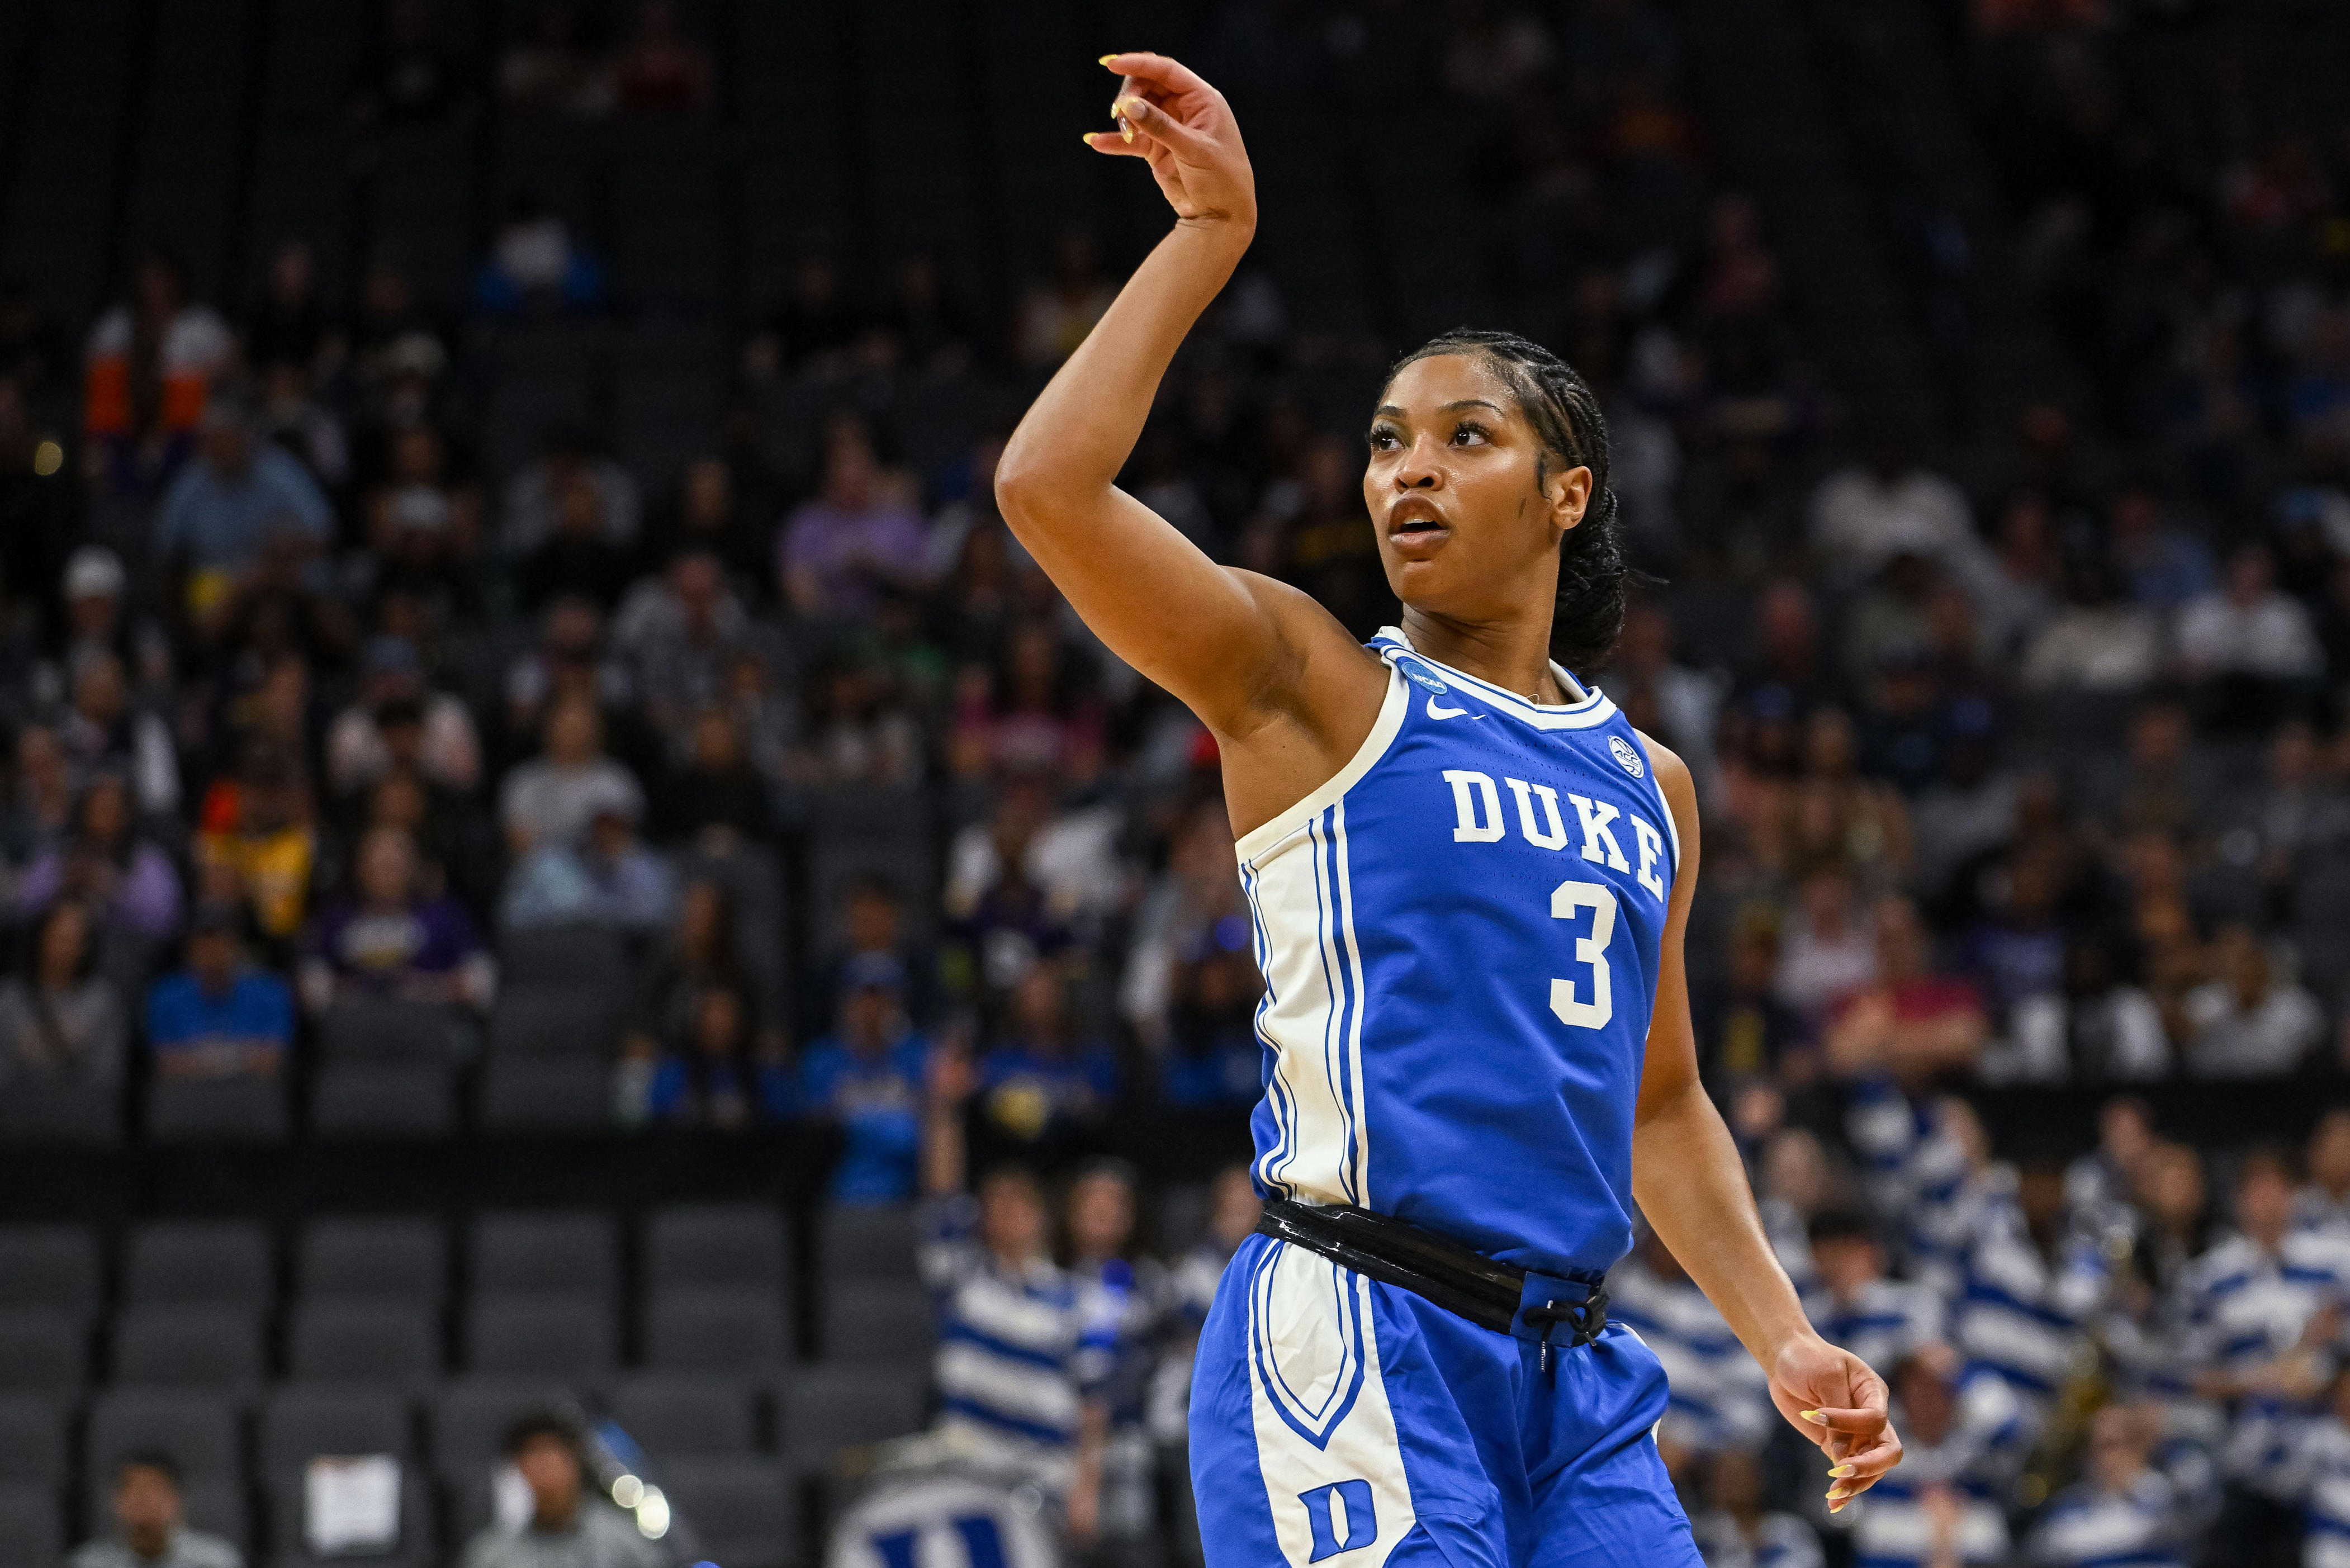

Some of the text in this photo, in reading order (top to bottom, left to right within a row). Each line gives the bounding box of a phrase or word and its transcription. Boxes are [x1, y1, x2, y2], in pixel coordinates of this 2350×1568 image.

[1411, 672, 1446, 689] NCAA
[1614, 750, 1639, 765] ACC
[1442, 770, 1664, 903] DUKE
[1550, 880, 1618, 1030] 3
[1297, 1478, 1378, 1564] D
